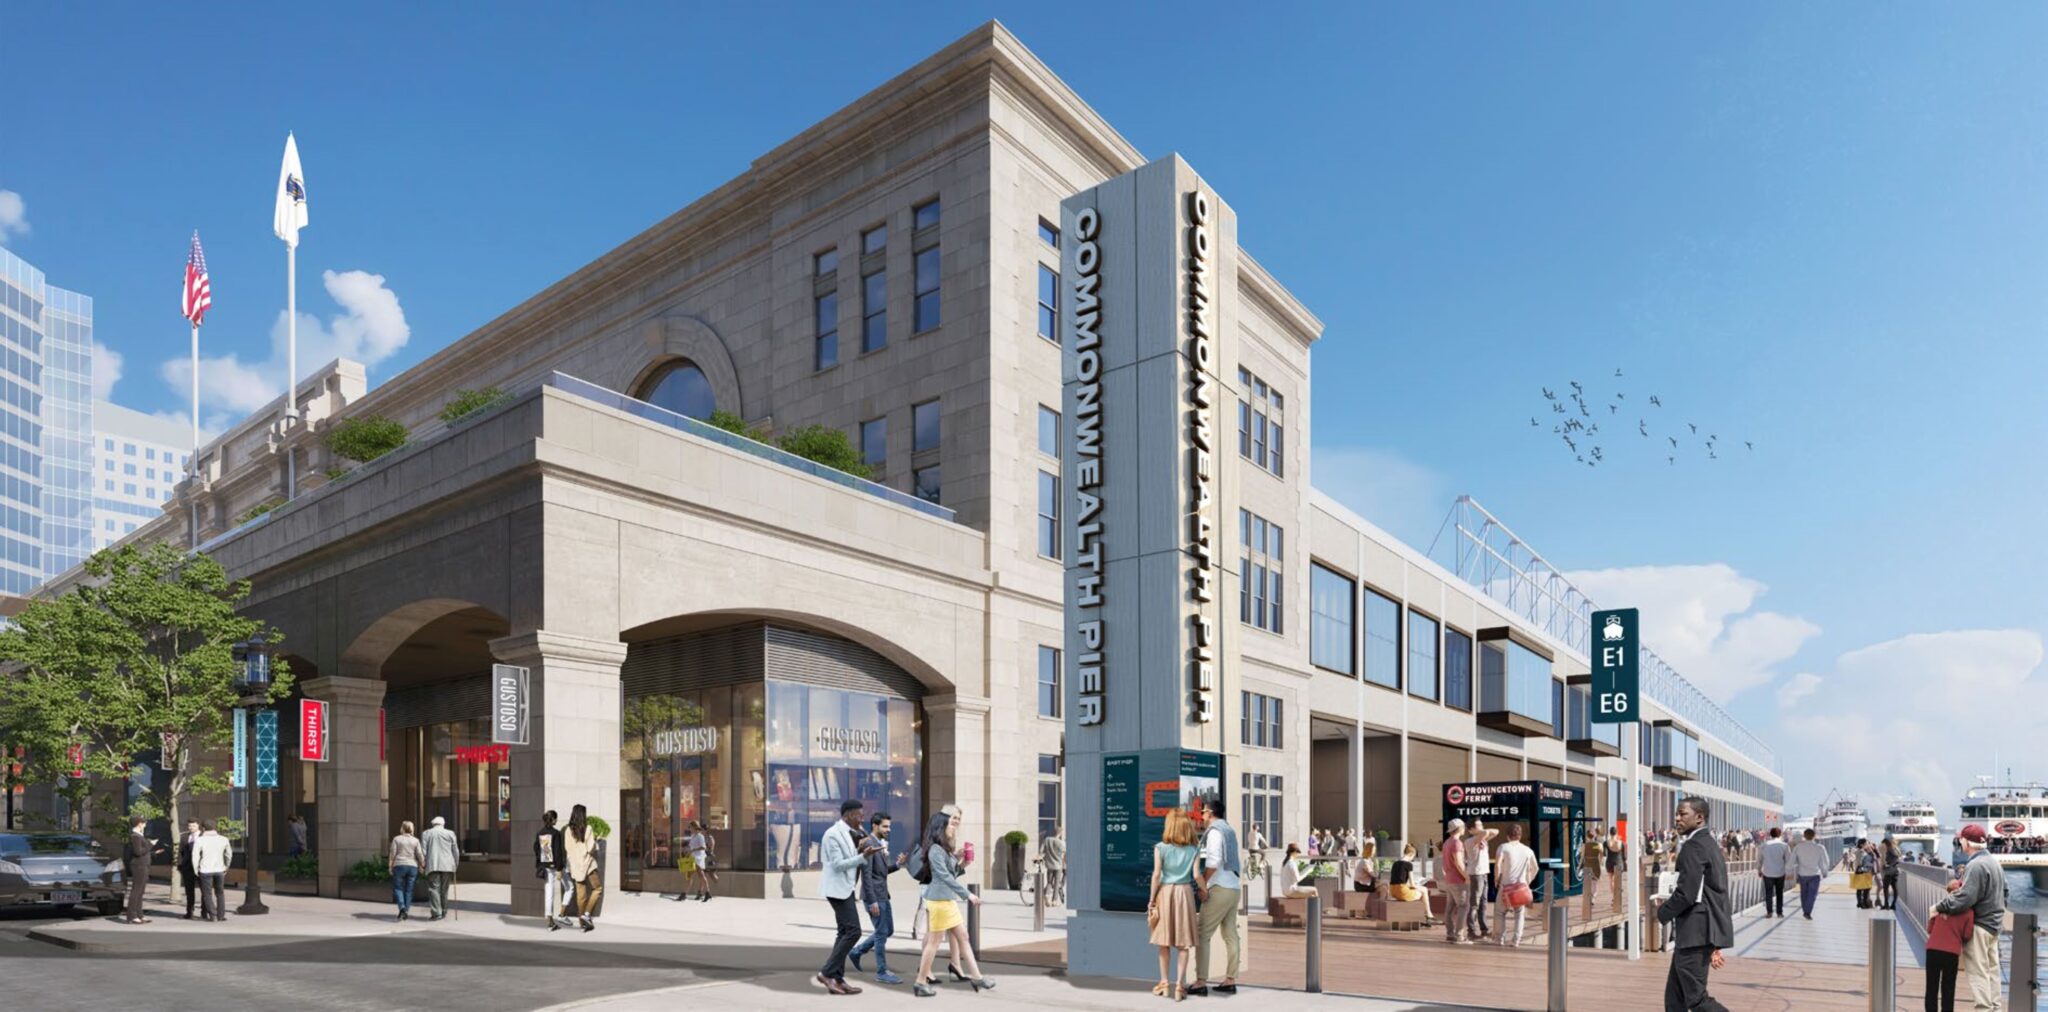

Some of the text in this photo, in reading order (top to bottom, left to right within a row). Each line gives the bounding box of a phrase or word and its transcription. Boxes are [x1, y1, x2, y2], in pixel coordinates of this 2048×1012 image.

[1075, 207, 1104, 726] COMMONWEALTH PIER
[1189, 191, 1213, 724] COMMONWEALTH PIER
[1603, 646, 1624, 667] E1
[500, 677, 517, 731] GUSTOSO
[1600, 692, 1628, 713] E6
[307, 708, 318, 755] THIRST
[656, 726, 718, 754] GUSTOSO
[819, 727, 879, 754] GUSTOSO
[455, 744, 511, 764] THIRST
[1465, 784, 1532, 795] PROVINCETOWN
[1465, 794, 1492, 803] FERRY
[1457, 806, 1519, 816] TICKETS
